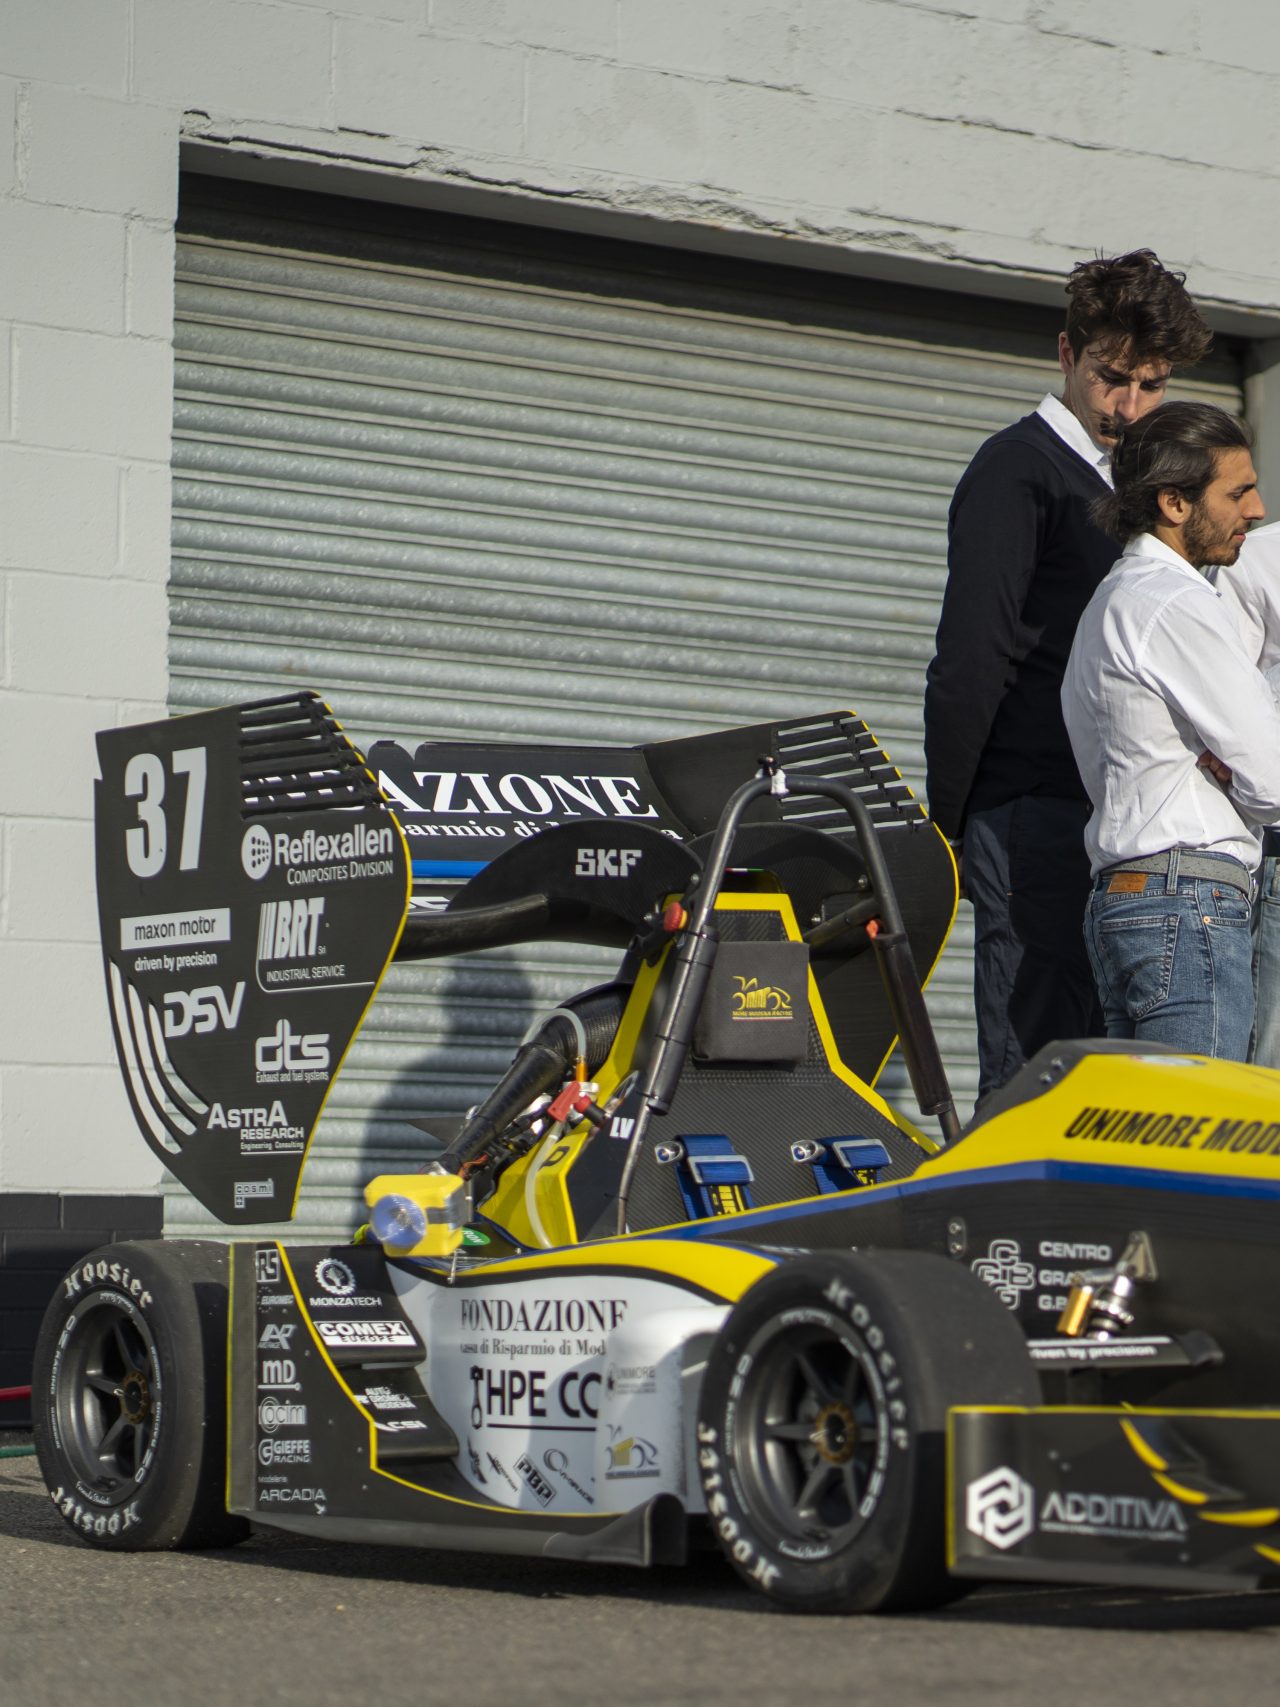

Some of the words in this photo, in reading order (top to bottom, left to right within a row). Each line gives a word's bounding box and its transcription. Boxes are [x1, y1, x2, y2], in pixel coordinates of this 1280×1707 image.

[378, 769, 660, 819] AZIONE
[124, 746, 207, 878] 37
[274, 823, 394, 866] Reflexallen
[575, 848, 643, 877] SKF
[134, 921, 176, 941] maxon
[179, 916, 217, 936] motor
[134, 953, 163, 972] driven
[164, 953, 174, 972] by
[176, 951, 218, 968] precision
[266, 967, 311, 983] INDUSTRIAL
[311, 964, 346, 979] SERVICE
[164, 981, 246, 1038] DSV
[255, 1019, 330, 1072] dts
[240, 1126, 305, 1140] RESEARCH
[609, 1116, 635, 1139] LV
[1063, 1106, 1211, 1149] UNIMORE
[1039, 1241, 1112, 1261] CENTRO
[64, 1260, 153, 1309] Hoosier
[1039, 1270, 1074, 1286] GRA
[309, 1297, 382, 1306] MONZATECH
[319, 1322, 406, 1336] COMEX
[340, 1335, 395, 1343] EUROPE
[492, 1338, 556, 1361] Risparmio
[559, 1339, 572, 1356] di
[575, 1340, 607, 1356] Mod
[486, 1369, 547, 1418] HPE
[273, 1440, 310, 1454] GIEFFE
[273, 1454, 310, 1463] RACING
[259, 1488, 326, 1501] ARCADIA
[1041, 1492, 1188, 1531] ADDITIVA
